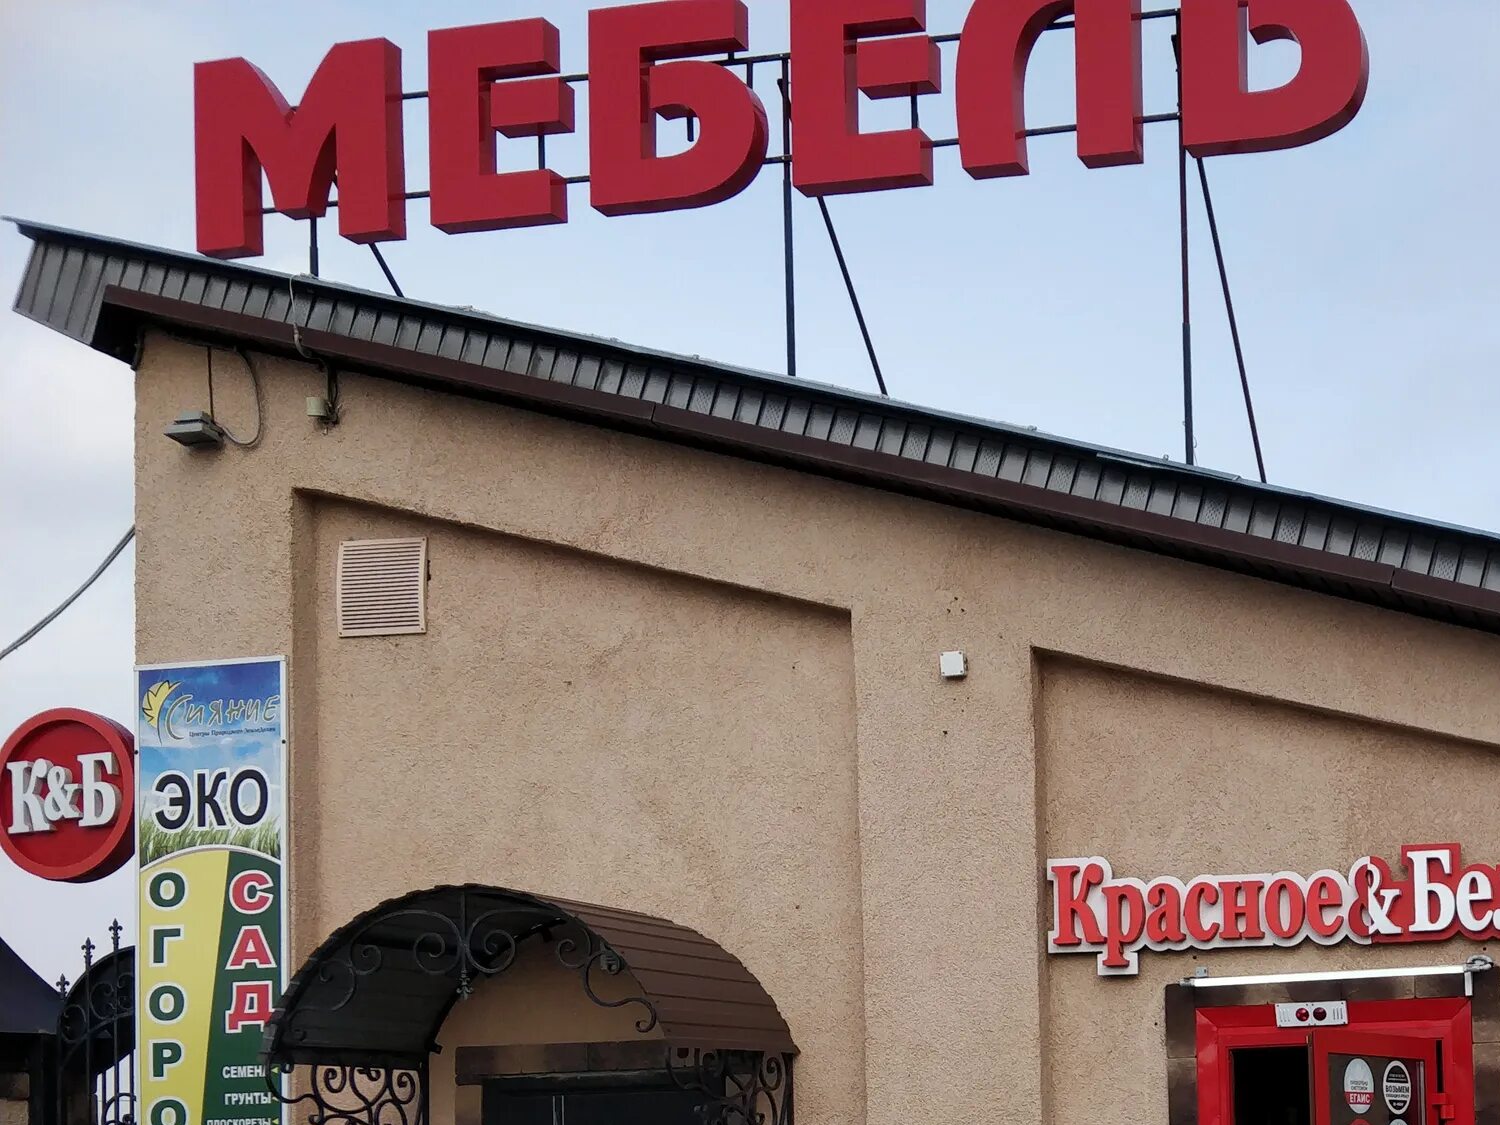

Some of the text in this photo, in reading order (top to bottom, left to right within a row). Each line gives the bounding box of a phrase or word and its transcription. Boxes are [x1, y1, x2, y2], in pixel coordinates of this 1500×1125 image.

[194, 0, 1369, 258] МЕБЕЛЬ
[7, 752, 120, 835] К&Б
[154, 768, 269, 831] ЭКО
[226, 870, 277, 1034] САД
[224, 1091, 272, 1106] ГРУНТЫ
[1349, 1092, 1371, 1104] ЕГАИС
